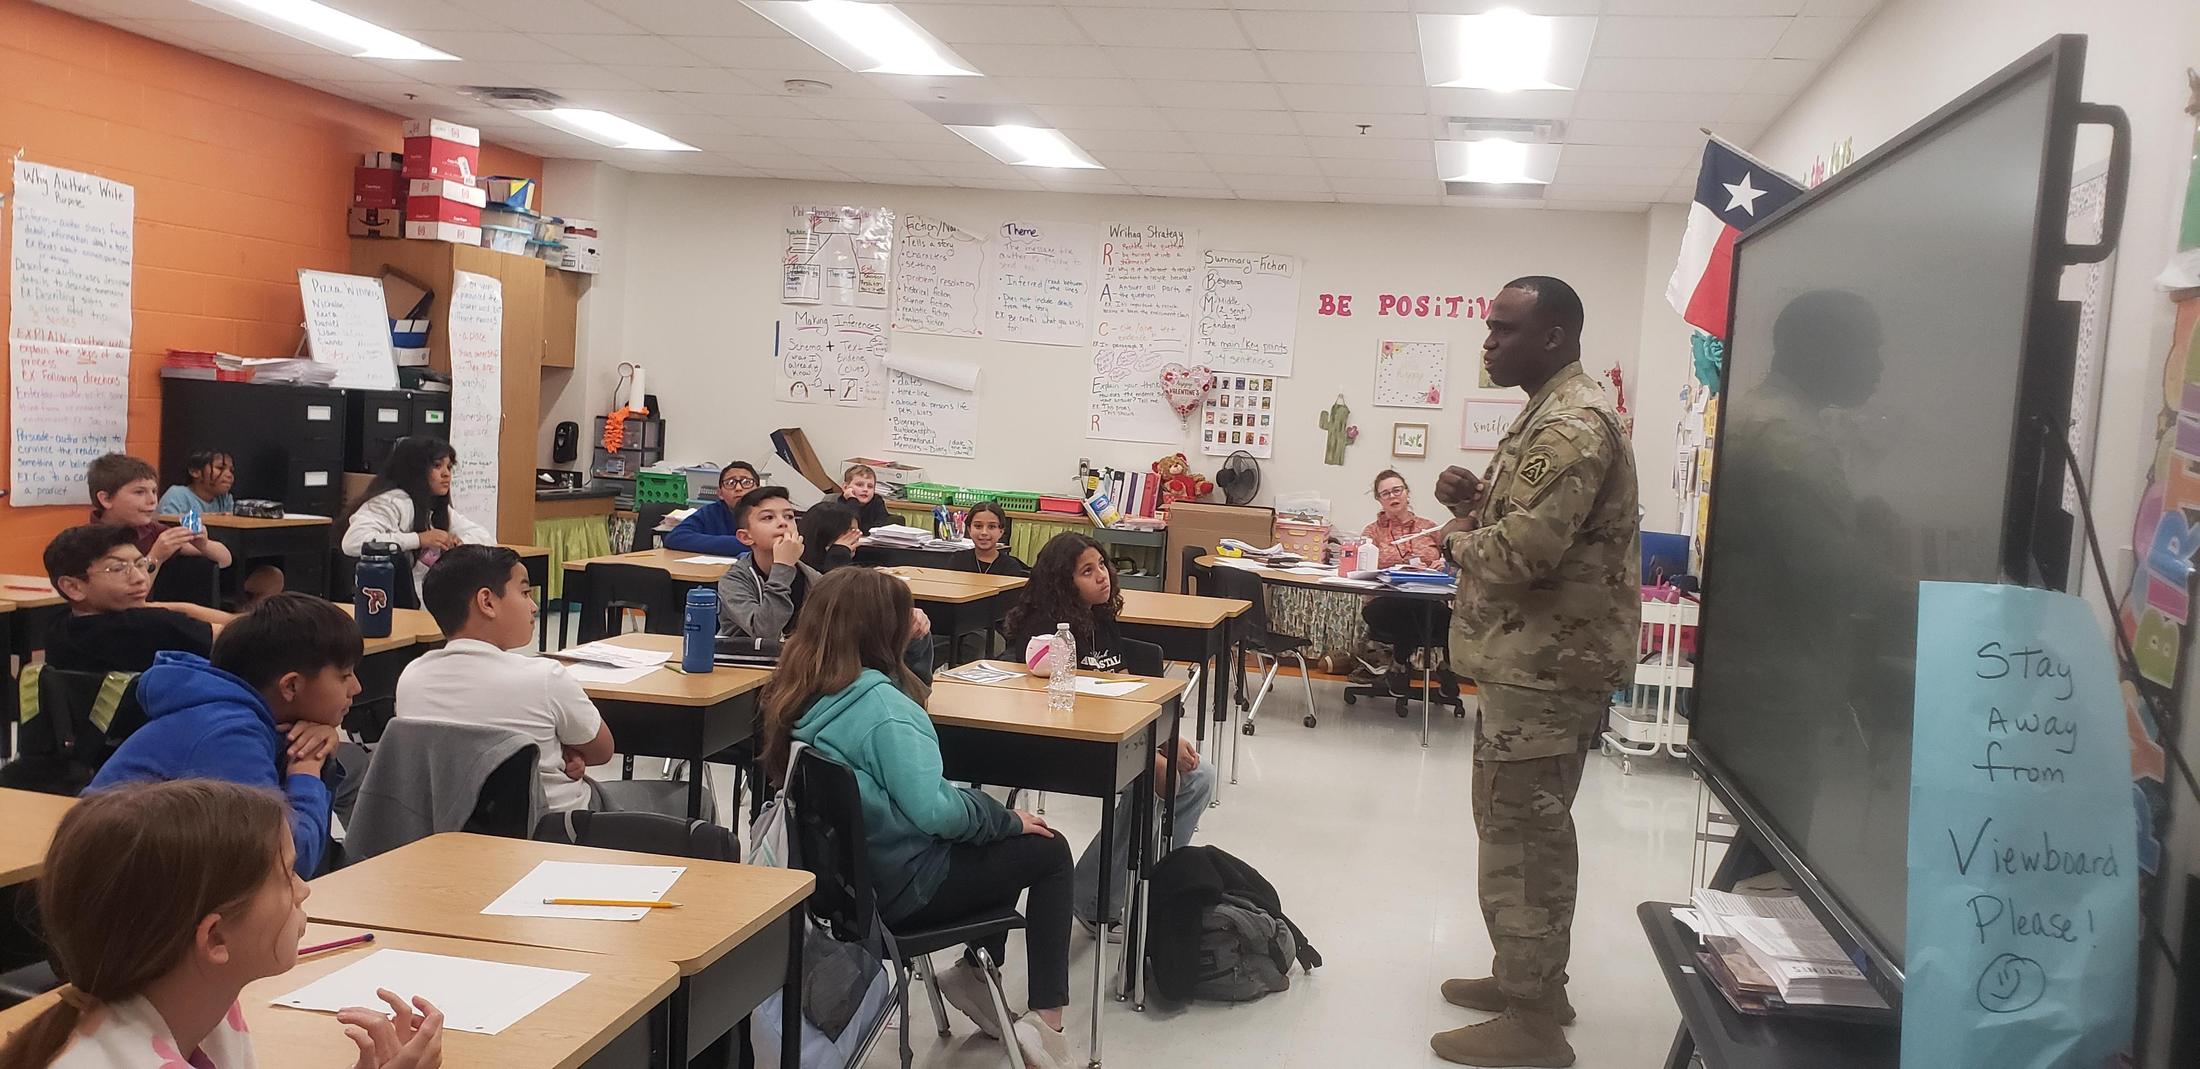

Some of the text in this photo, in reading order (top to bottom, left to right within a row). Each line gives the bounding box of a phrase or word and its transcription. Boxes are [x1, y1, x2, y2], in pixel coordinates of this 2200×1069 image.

[23, 168, 124, 201] Why Authors Write
[1002, 223, 1039, 238] Theme
[1109, 223, 1184, 246] Writing Strategy
[906, 235, 926, 248] Tells
[937, 239, 955, 257] story
[1103, 242, 1113, 266] R
[1204, 250, 1252, 275] Summary
[1005, 274, 1043, 289] Inferred
[1100, 283, 1112, 302] A
[1318, 294, 1353, 317] BE
[795, 311, 882, 336] Making Inferences
[1098, 321, 1109, 336] C
[1201, 337, 1216, 347] The
[897, 377, 923, 387] dates
[1091, 376, 1119, 394] Explain
[1091, 414, 1100, 432] R
[1473, 416, 1509, 435] smile
[1988, 707, 2078, 754] Away
[1972, 741, 2065, 783] from
[1948, 817, 2119, 876] Viewboard
